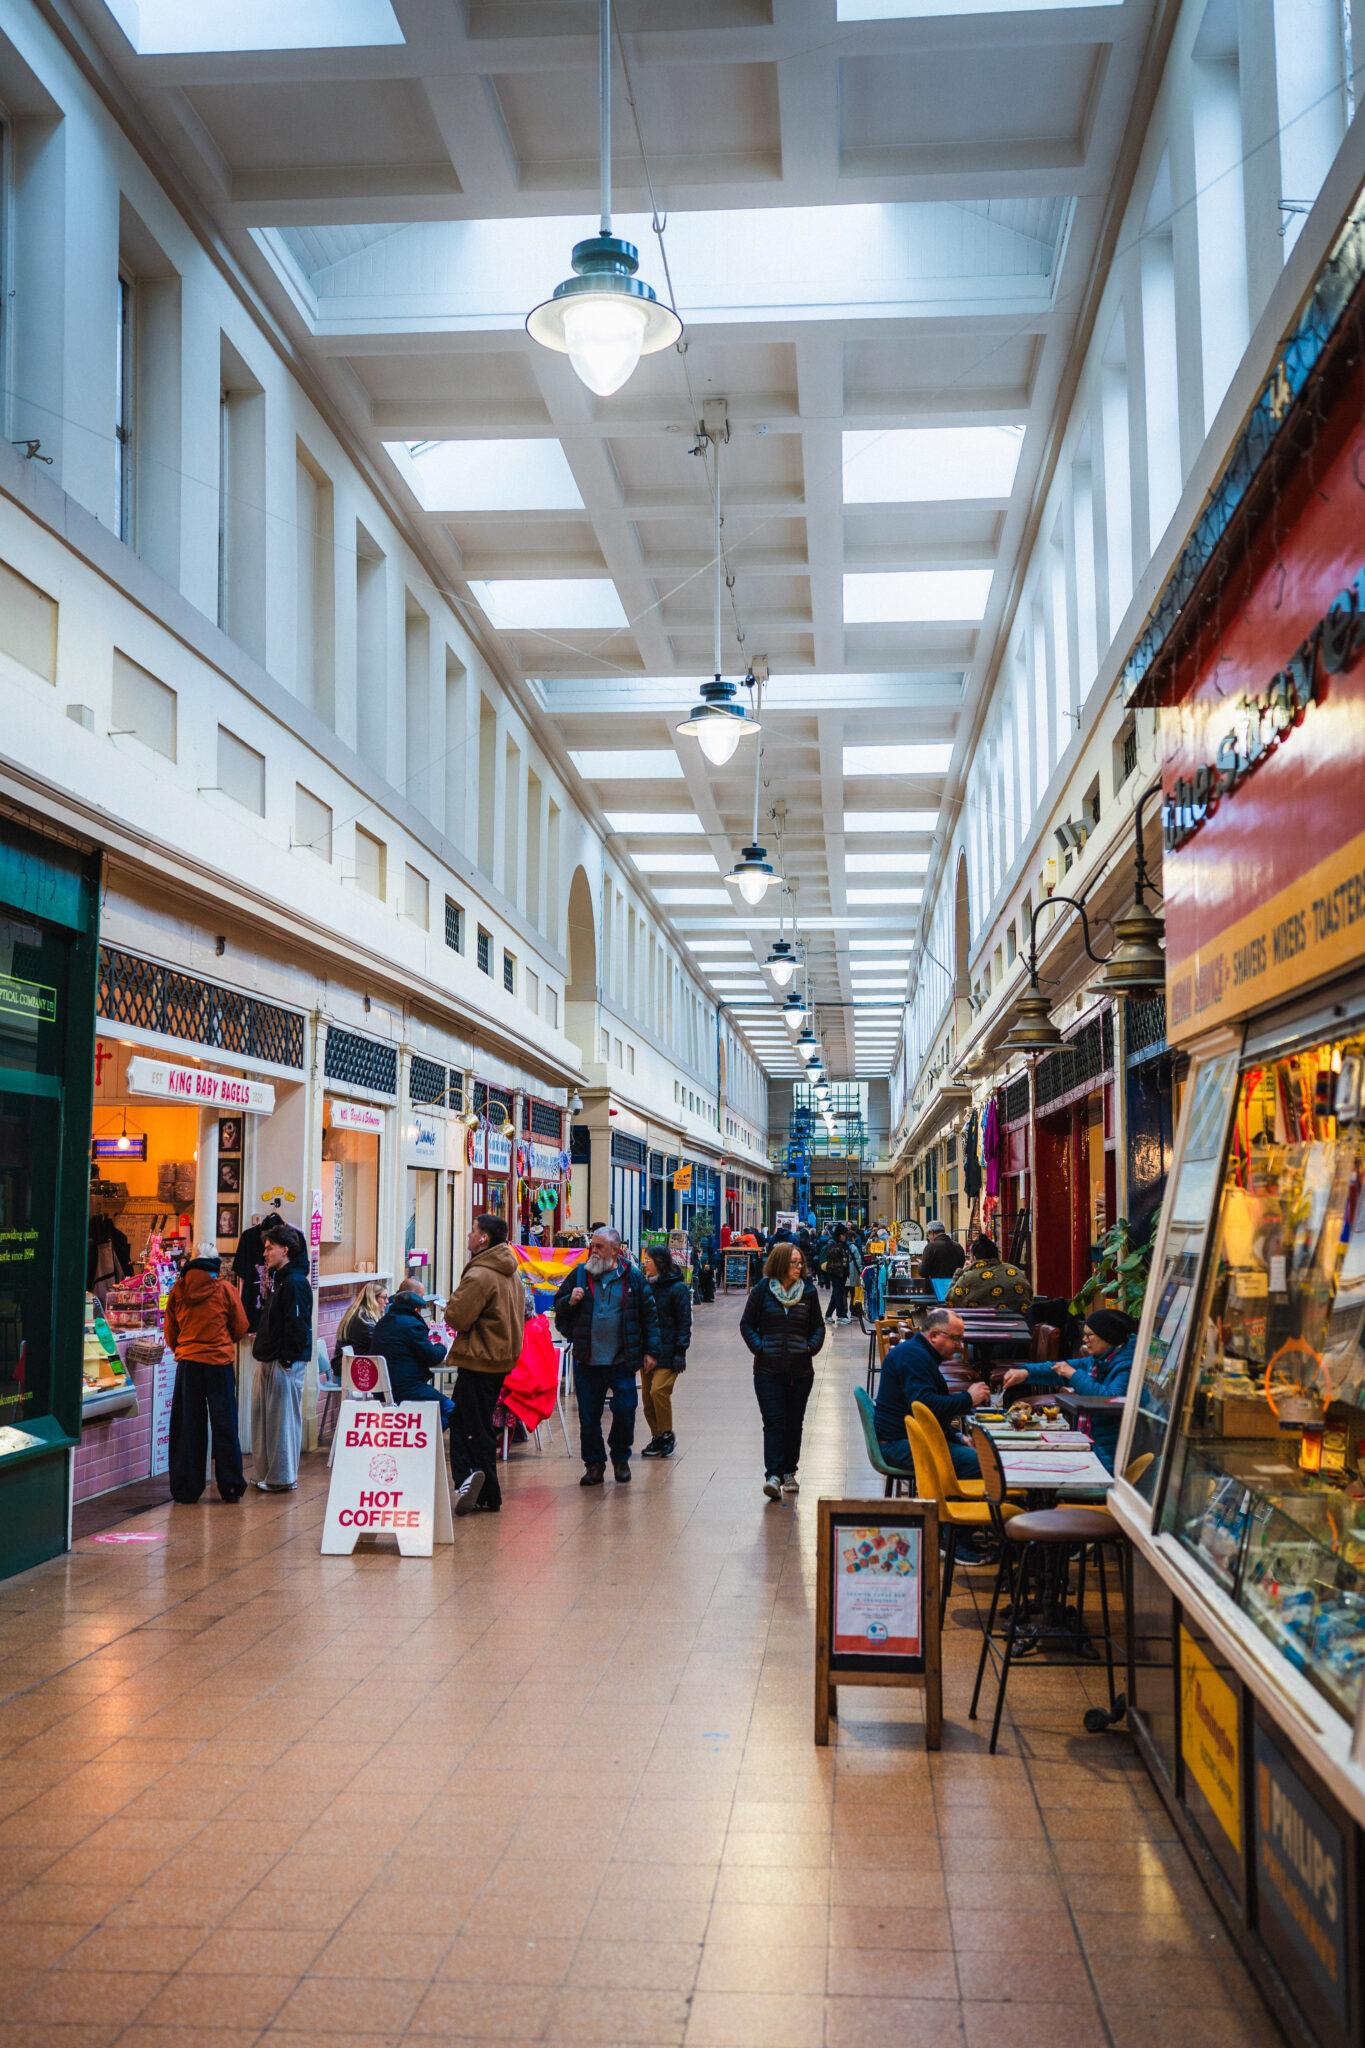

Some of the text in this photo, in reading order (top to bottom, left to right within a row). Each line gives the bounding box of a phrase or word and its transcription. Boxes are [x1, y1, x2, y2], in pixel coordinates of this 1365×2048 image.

[1161, 764, 1210, 854] the
[1233, 934, 1267, 986] SHAVERS
[1272, 909, 1306, 967] MIXERS
[19, 993, 47, 1010] COMPANY
[168, 1070, 193, 1095] KING
[196, 1074, 219, 1101] BABY
[221, 1080, 251, 1105] BAGELS
[354, 1412, 422, 1430] FRESH
[345, 1430, 428, 1449] BAGELS
[359, 1490, 404, 1508] HOT
[338, 1508, 421, 1528] COFFEE
[1272, 1778, 1338, 1924] PHILIPS
